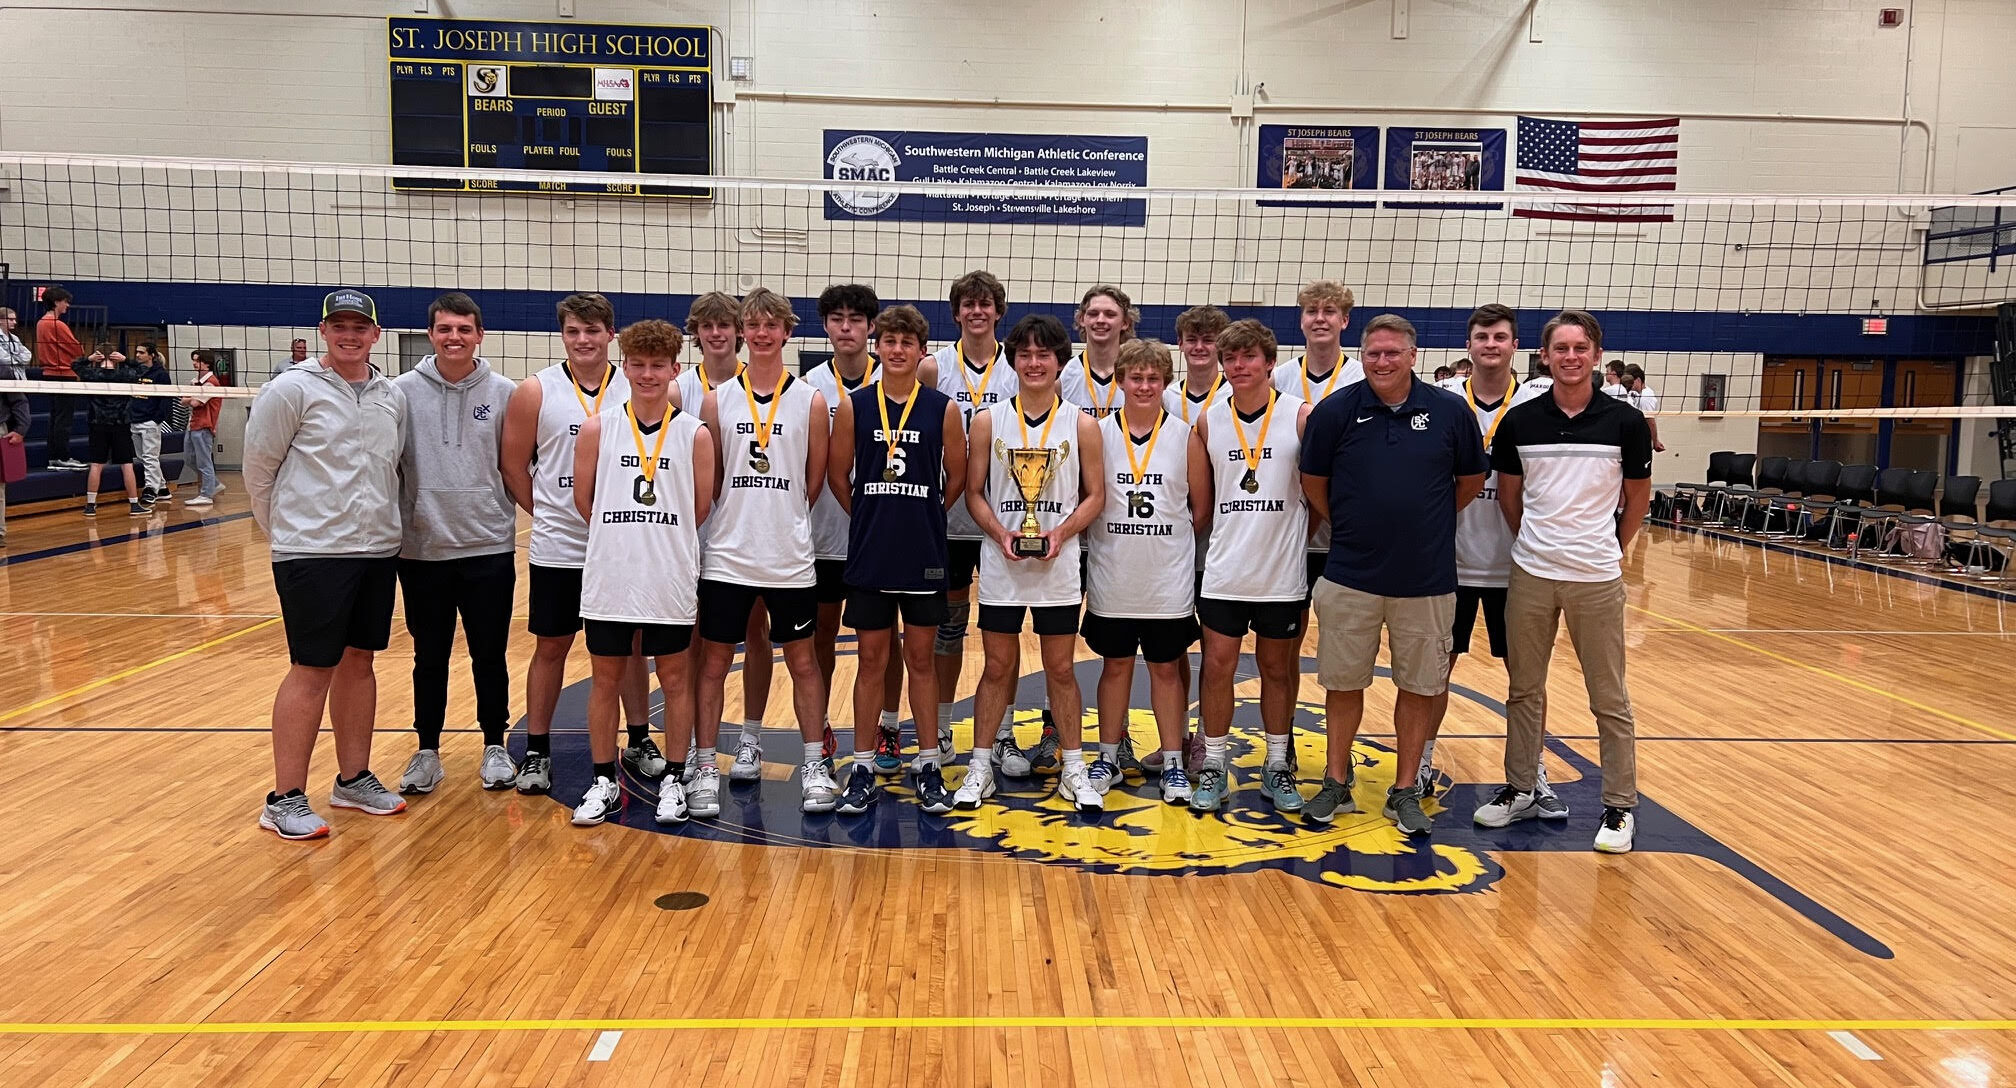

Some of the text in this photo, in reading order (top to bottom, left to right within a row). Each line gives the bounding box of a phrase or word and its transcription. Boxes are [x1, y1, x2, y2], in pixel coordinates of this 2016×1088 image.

[392, 28, 706, 58] ST. JOSEPH HIGH SCHOOL
[396, 65, 455, 76] PLYR FLS PTS
[643, 73, 701, 84] PLYR FLS PTS
[474, 99, 514, 112] BEARS
[536, 107, 567, 117] PERIOD
[588, 102, 627, 115] GUEST
[1287, 128, 1352, 137] ST JOSEPH BEARS
[1414, 131, 1478, 140] ST JOSEPH BEARS
[470, 144, 497, 153] FOULS
[523, 145, 581, 156] PLAYER FOUL
[606, 147, 633, 157] FOULS
[830, 136, 899, 163] SOUTHWESTERN MICHIGAN
[904, 145, 1145, 161] Southwestern Michigan Athletic Conference
[838, 167, 890, 181] SMAC
[933, 164, 1116, 177] Battle Creek Central Battle Creek Lakeview
[471, 179, 498, 189] SCORE
[538, 181, 567, 191] MATCH
[606, 183, 633, 193] SCORE
[959, 177, 1005, 185] Kalamazoo
[1007, 178, 1038, 186] Central
[1045, 179, 1091, 187] Kalamazoo
[952, 202, 964, 212] St.
[966, 203, 995, 213] Joseph
[1053, 204, 1096, 214] Lakeshore
[956, 391, 999, 404] SOTH
[736, 422, 783, 435] SOH
[873, 429, 921, 444] SUTH
[620, 455, 671, 470] SOH
[749, 440, 769, 472] 5
[886, 447, 907, 477] 6
[731, 475, 790, 491] HRISTIAN
[864, 482, 930, 499] CHRISTIAN
[1000, 500, 1063, 514] CHRITIAN
[1126, 490, 1155, 518] 16
[602, 510, 679, 526] CHRISTIAN
[1106, 522, 1173, 536] CHRISTIAN
